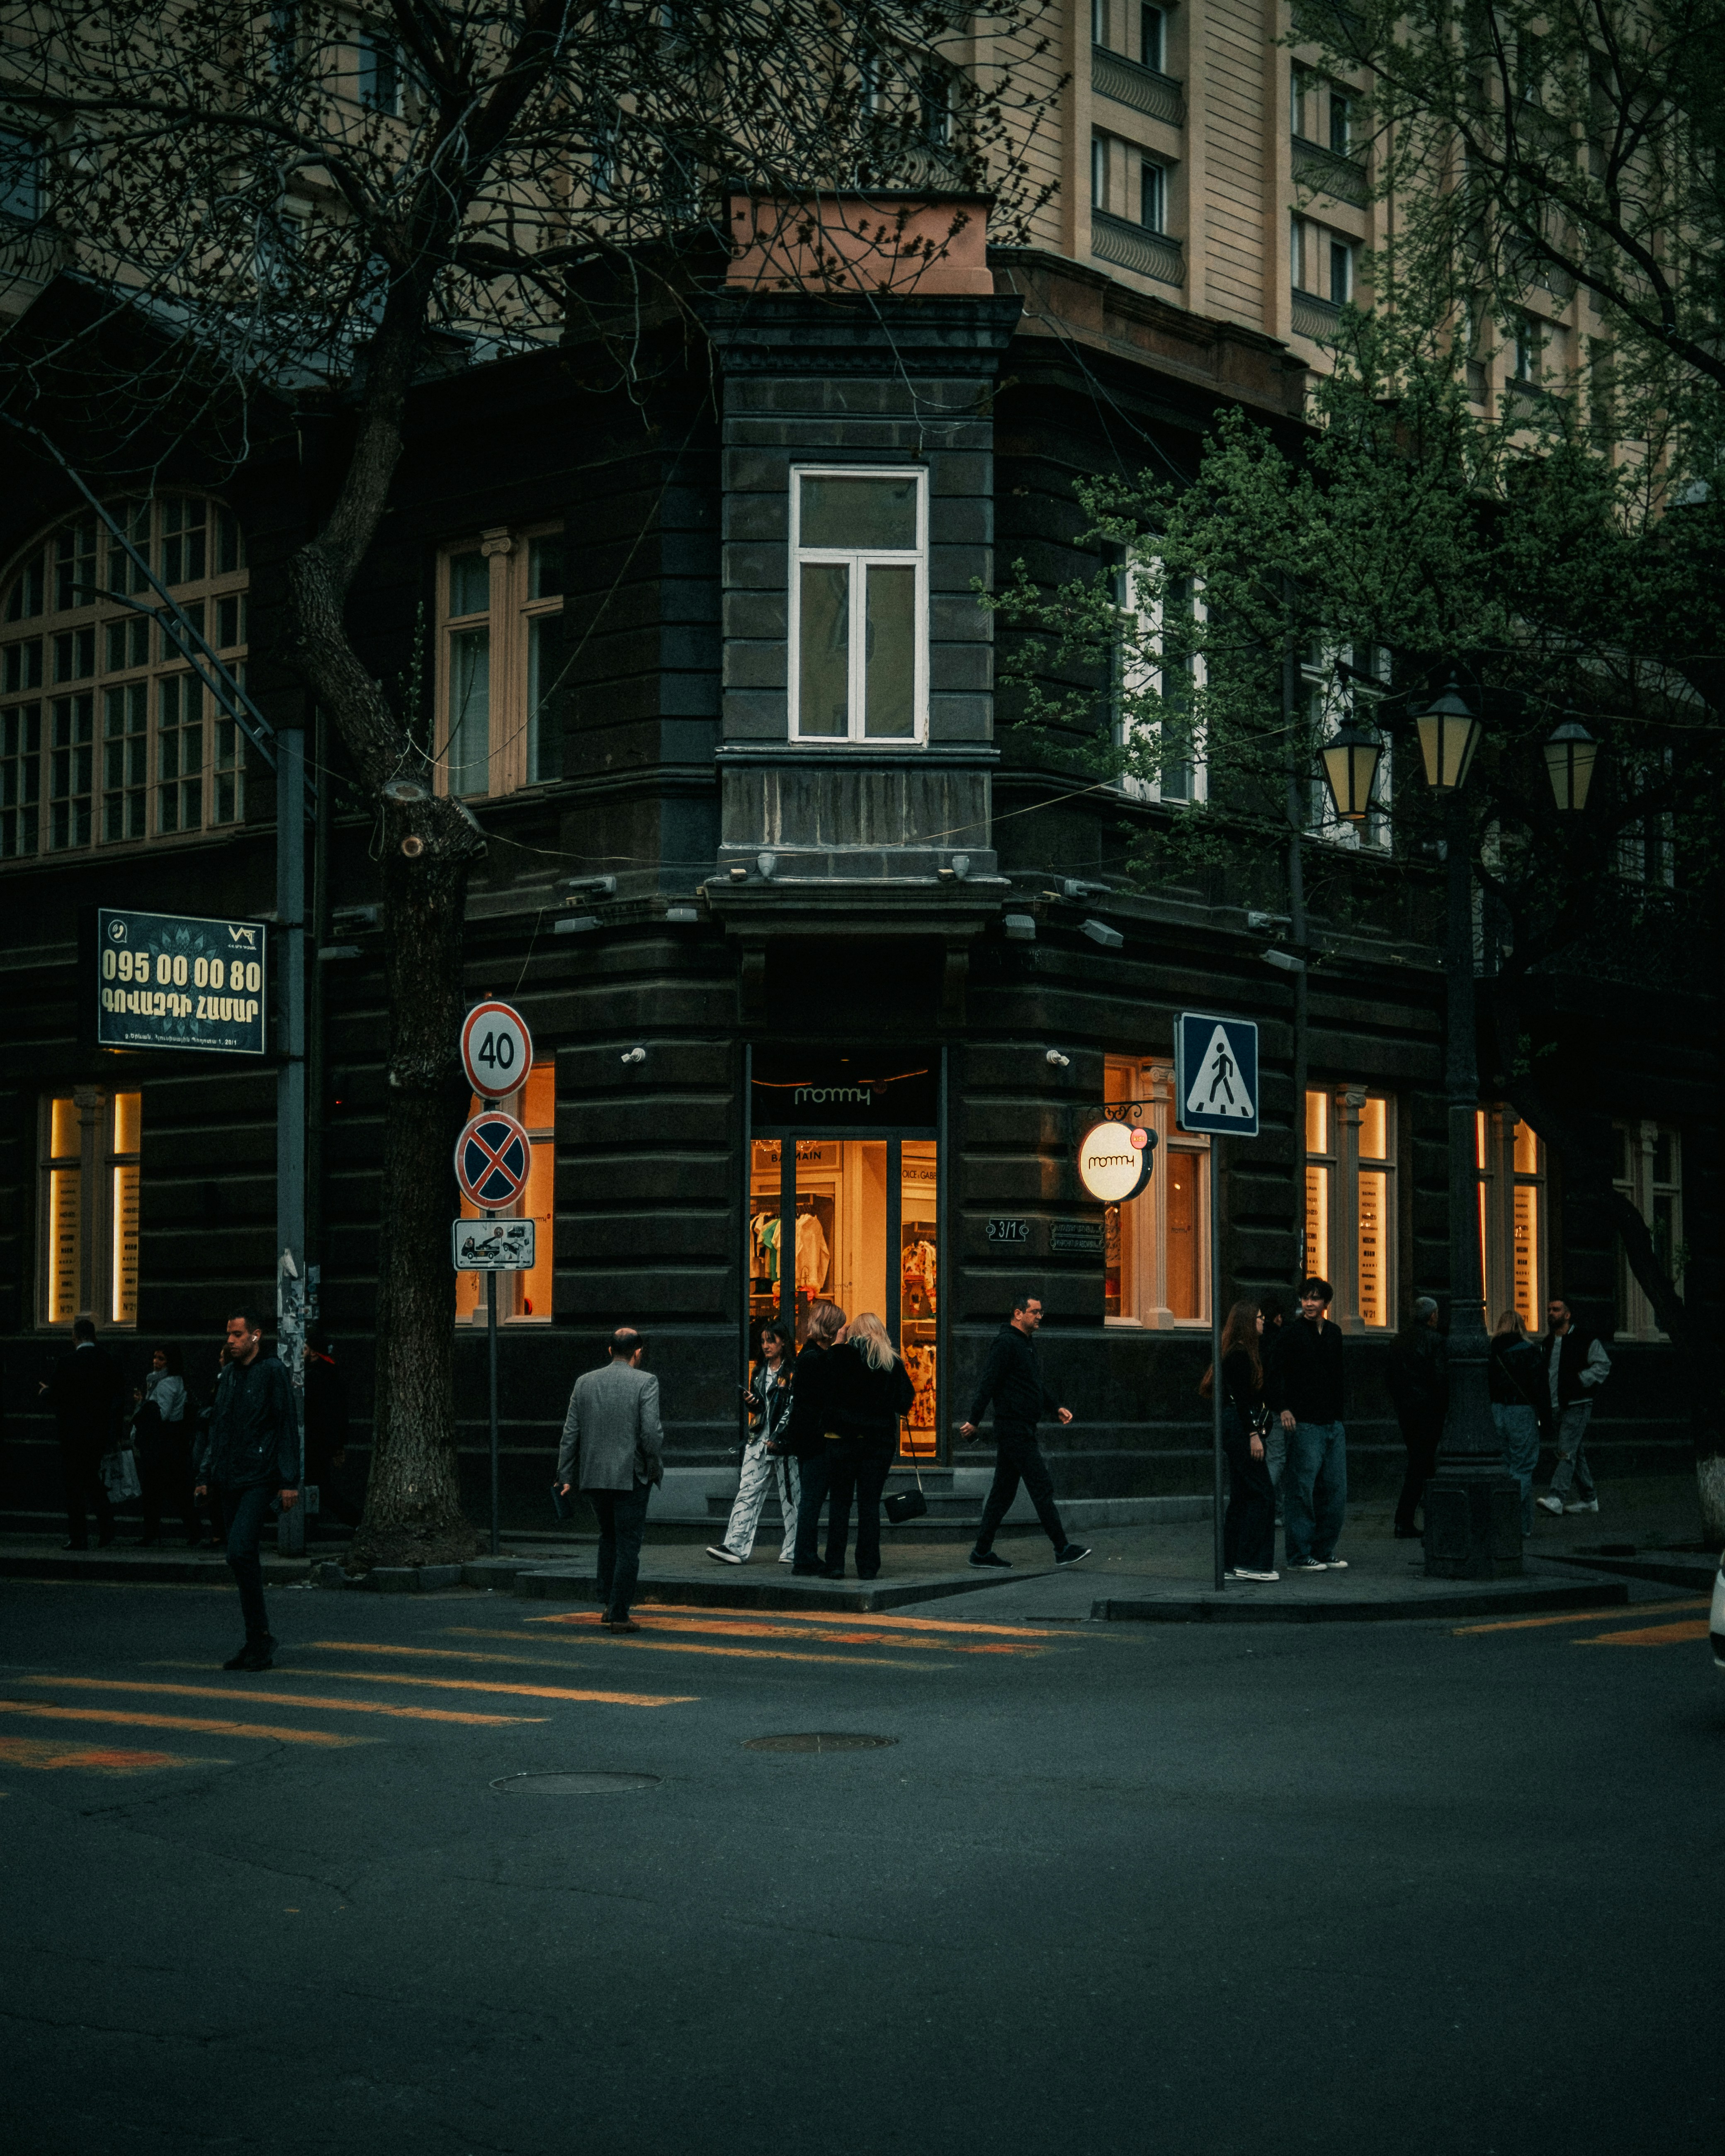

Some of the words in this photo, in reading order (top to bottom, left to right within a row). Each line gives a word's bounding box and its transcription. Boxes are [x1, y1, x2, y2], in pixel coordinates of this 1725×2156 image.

[102, 949, 150, 983] 095
[156, 954, 188, 986] 00
[194, 957, 224, 990] 00
[230, 960, 261, 993] 80
[102, 988, 192, 1018] ԳՈՎԱԶԴԻ
[196, 995, 259, 1023] ՀԱՄԱՐ
[478, 1031, 515, 1070] 40
[795, 1087, 870, 1105] mommy
[771, 1151, 821, 1162] BMAIN
[1088, 1155, 1135, 1170] mommy
[902, 1170, 917, 1179] OLCE
[998, 1221, 1017, 1238] 3/1
